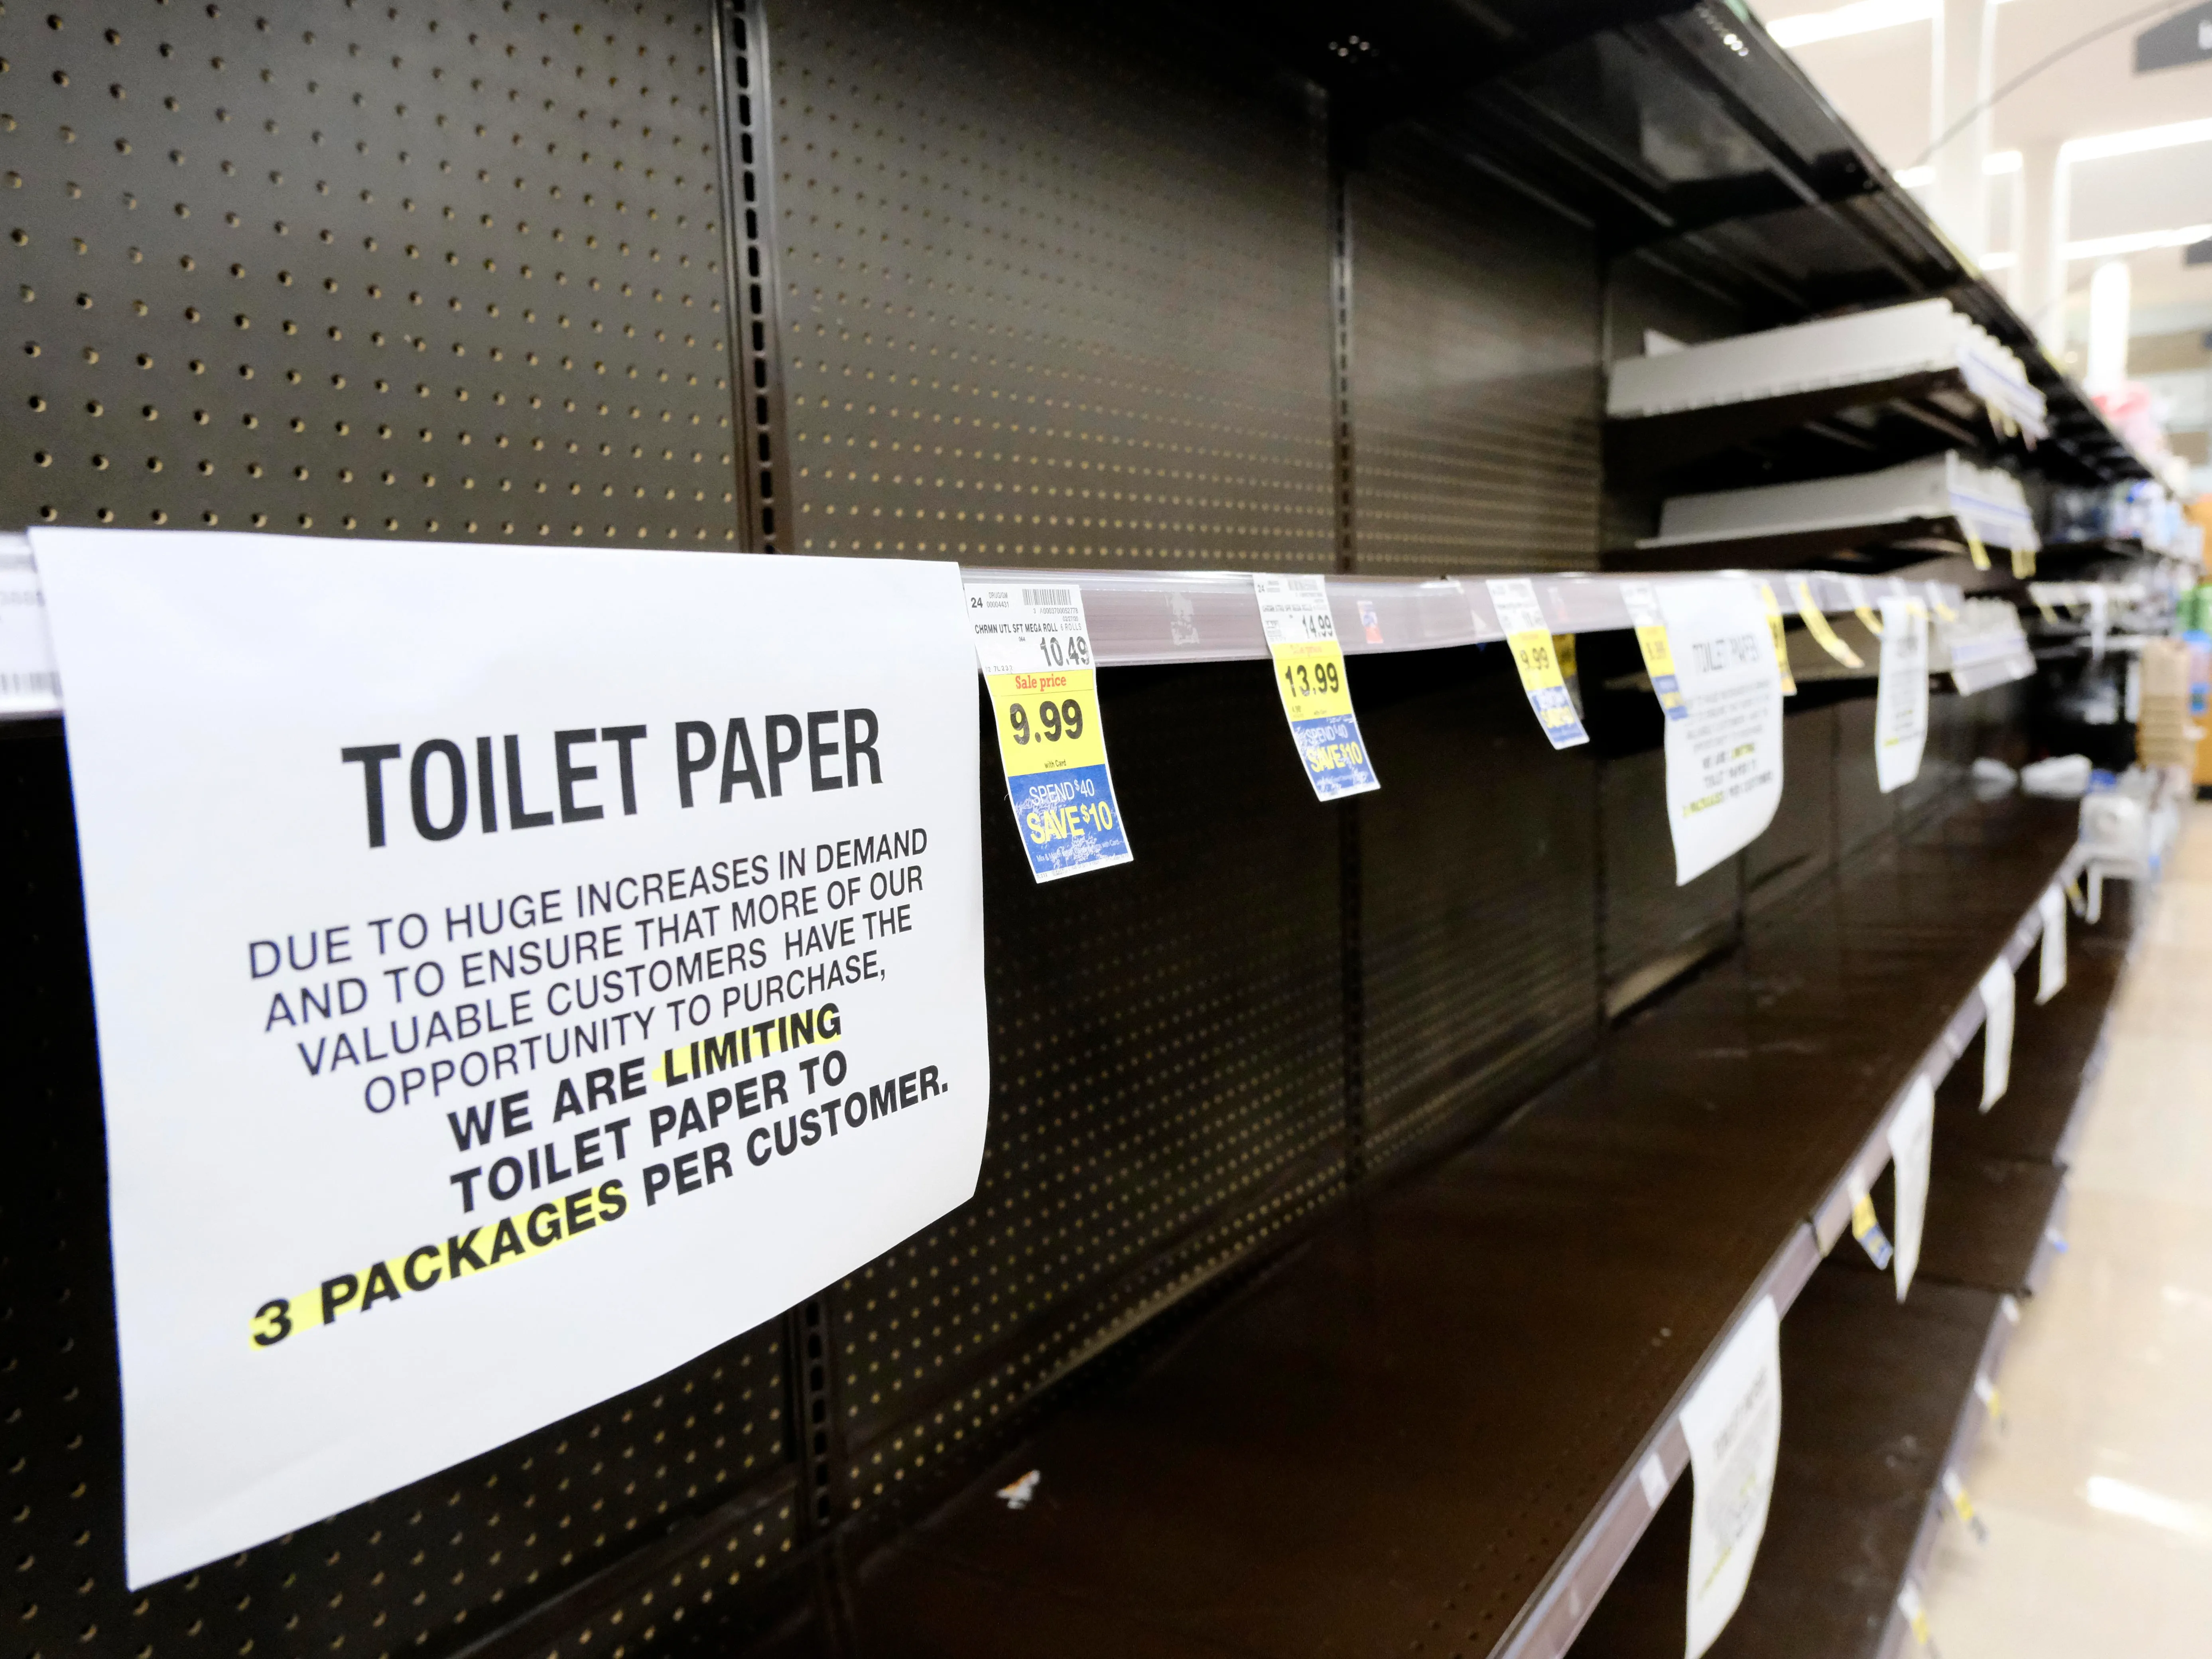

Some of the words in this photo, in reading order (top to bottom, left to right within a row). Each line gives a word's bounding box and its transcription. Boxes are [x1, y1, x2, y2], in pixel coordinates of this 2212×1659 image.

[971, 597, 983, 608] 24
[975, 624, 998, 634] CHRMN
[999, 624, 1011, 633] UTL
[1012, 623, 1023, 633] SFT
[1025, 623, 1042, 633] MEGA
[1043, 623, 1058, 632] ROLL
[1065, 623, 1082, 631] ROLLS
[1302, 615, 1333, 639] 14.99
[1040, 636, 1090, 667] 10.49
[1015, 675, 1037, 689] Sale
[1040, 674, 1066, 692] price
[1285, 662, 1339, 697] 13.99
[1010, 699, 1083, 745] 9.99
[1306, 726, 1335, 744] SPEND
[1044, 760, 1055, 768] with
[1055, 759, 1066, 768] Card
[1307, 744, 1345, 772] SAVE
[341, 724, 648, 849] TOILET
[674, 707, 883, 809] PAPER
[1029, 782, 1075, 806] SPEND
[1073, 779, 1095, 797] $40
[1026, 806, 1085, 844] SAVE
[1080, 801, 1113, 832] $10
[249, 925, 352, 979] DUE
[367, 913, 428, 955] TO
[445, 889, 563, 942] HUGE
[577, 854, 769, 918] INCREASES
[779, 847, 806, 881] IN
[816, 827, 928, 874] DEMAND
[266, 977, 368, 1032] AND
[383, 961, 444, 1003] TO
[461, 924, 623, 989] ENSURE
[634, 904, 721, 951] THAT
[731, 885, 819, 932] MORE
[827, 876, 861, 910] OF
[869, 865, 924, 901] OUR
[297, 989, 533, 1076] VALUABLE
[547, 937, 767, 1017] CUSTOMERS
[784, 916, 856, 961] HAVE
[861, 903, 913, 941] THE
[364, 1006, 656, 1114] OPPORTUNITY
[666, 993, 711, 1032] TO
[723, 949, 886, 1019] PURCHASE,
[446, 1090, 533, 1153] WE
[552, 1056, 647, 1123] ARE
[664, 1002, 842, 1088] LIMITING
[449, 1116, 632, 1214] TOILET
[649, 1069, 789, 1148] PAPER
[798, 1049, 847, 1095] TO
[253, 1298, 292, 1347] 3
[320, 1178, 627, 1326] PACKAGES
[642, 1141, 733, 1207] PER
[746, 1064, 949, 1167] CUSTOMER.
